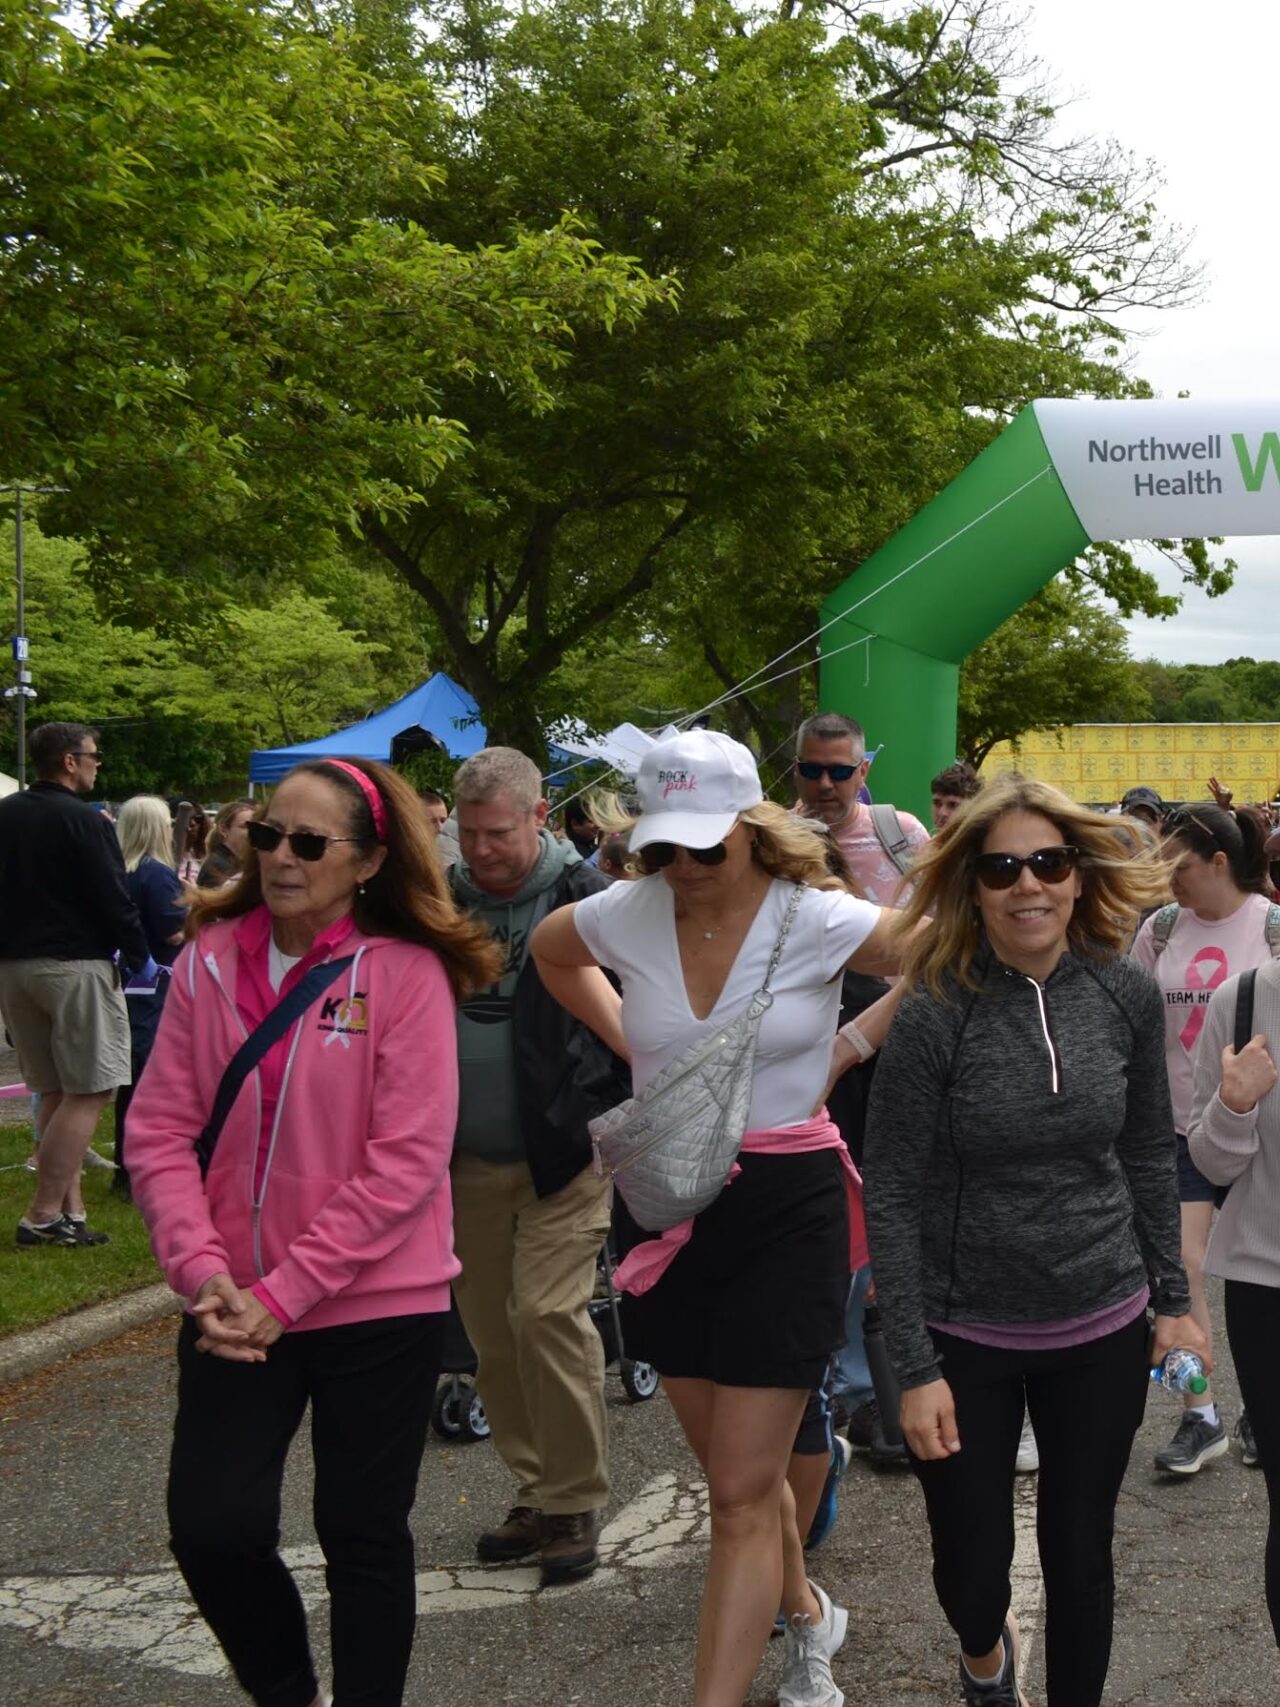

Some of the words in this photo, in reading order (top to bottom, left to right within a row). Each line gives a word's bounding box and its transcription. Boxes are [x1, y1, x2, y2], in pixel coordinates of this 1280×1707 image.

[1088, 434, 1221, 463] Northwell
[1134, 471, 1222, 497] Health
[658, 770, 688, 783] ROCK
[663, 774, 697, 799] pink
[1166, 991, 1194, 1004] TEAM
[1198, 991, 1213, 1004] HE
